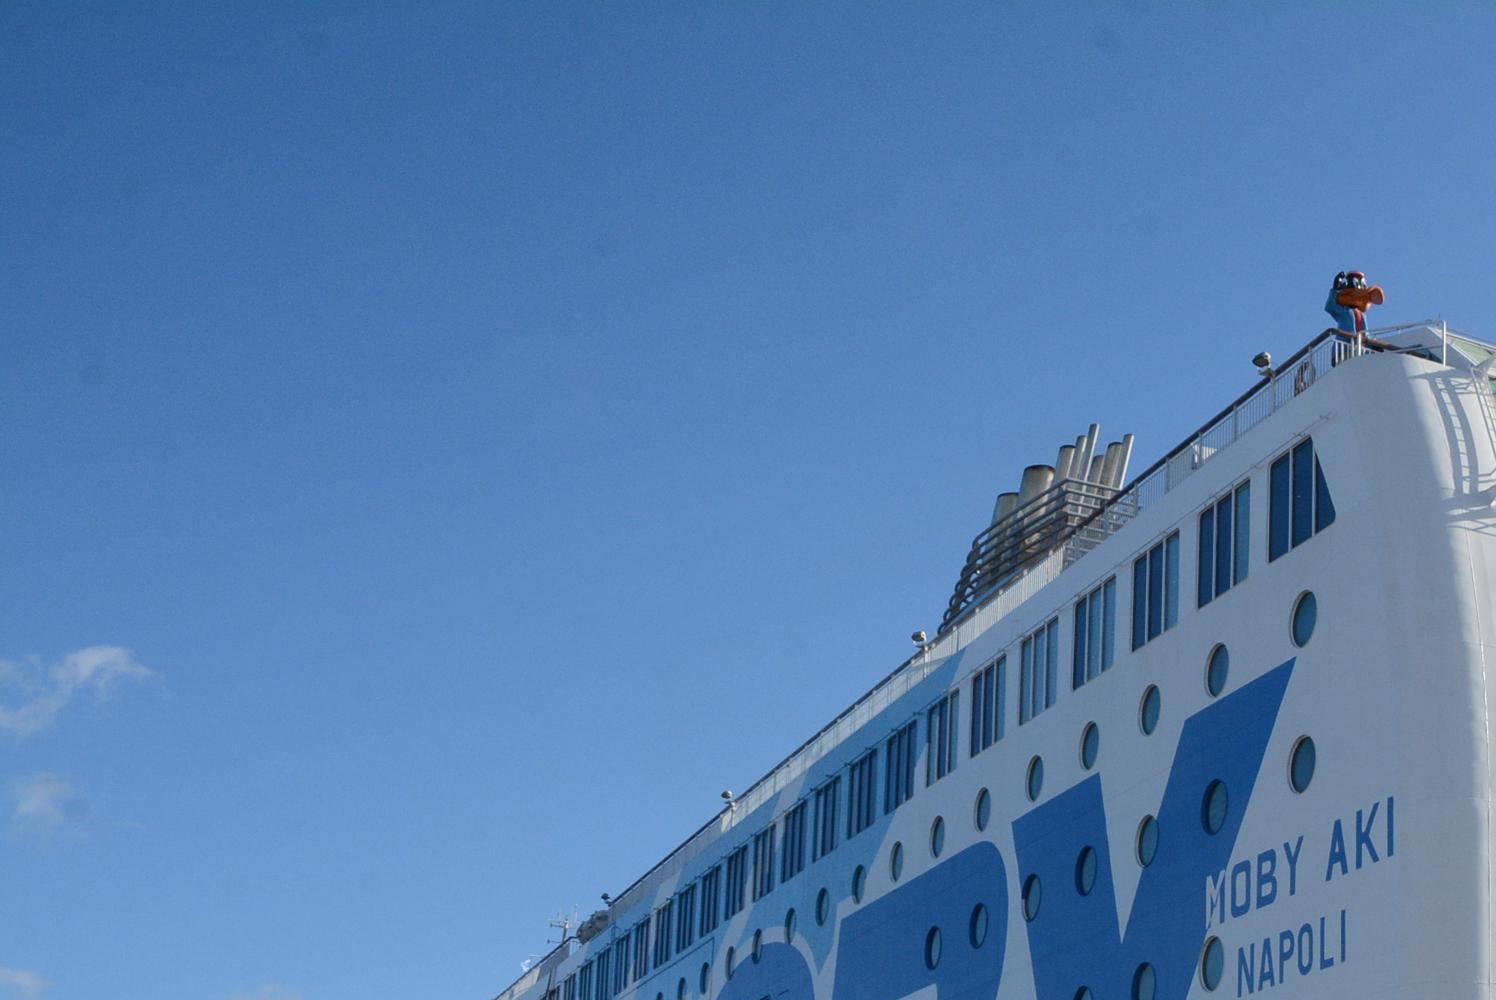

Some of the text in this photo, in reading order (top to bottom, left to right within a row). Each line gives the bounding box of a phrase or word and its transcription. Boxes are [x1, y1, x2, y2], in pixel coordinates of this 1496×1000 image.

[1205, 796, 1395, 929] MOBY AKI
[1237, 909, 1348, 998] NAPOLI
